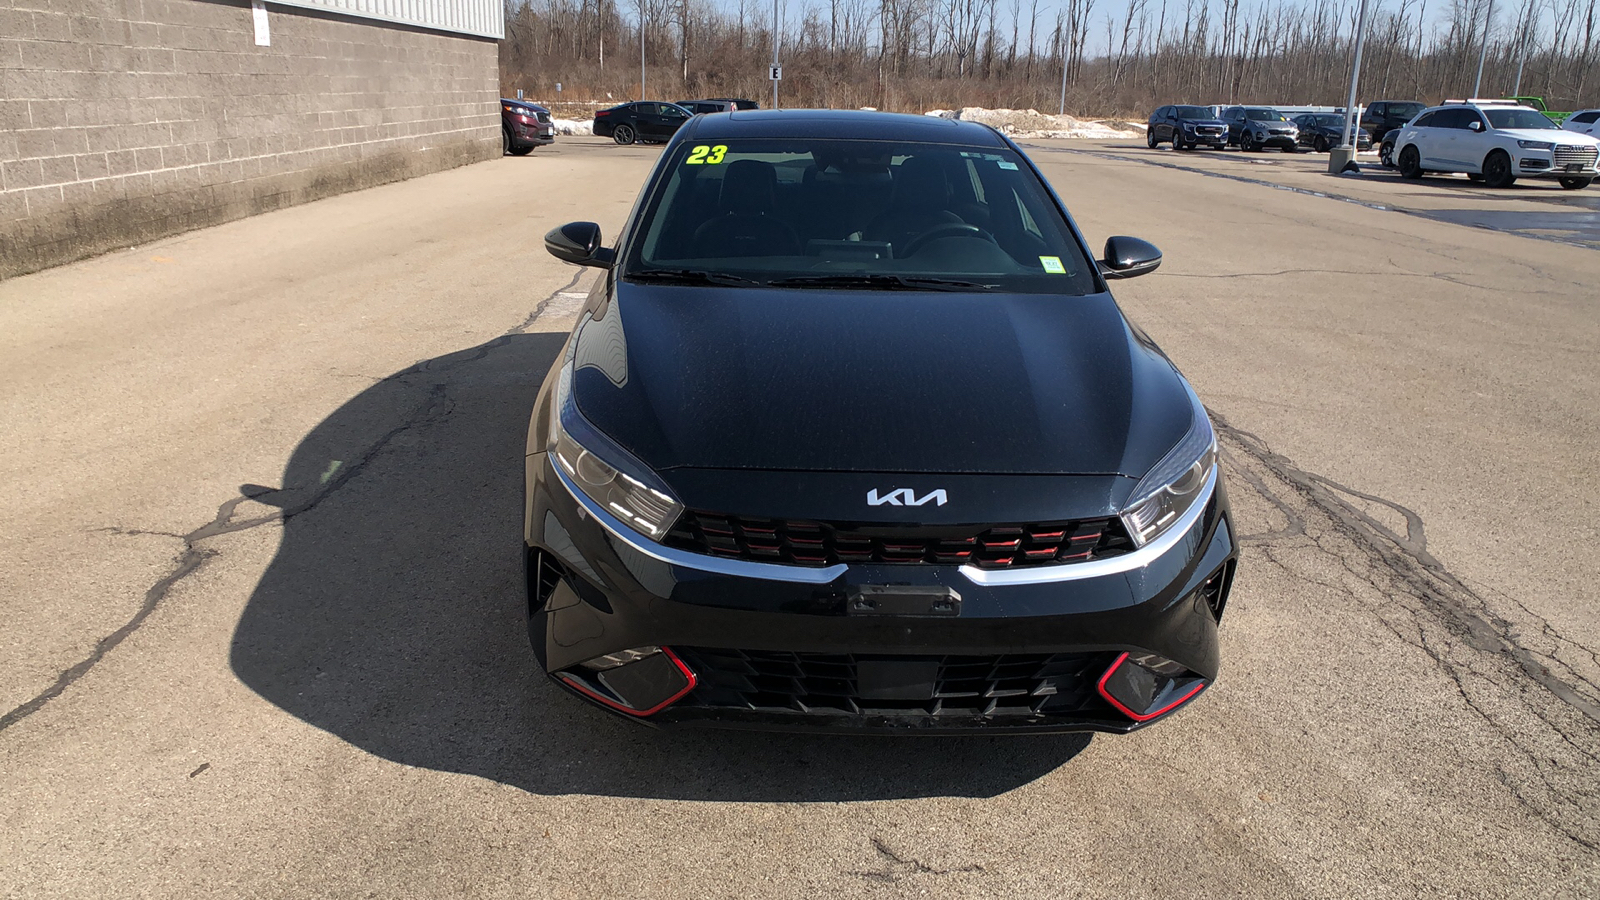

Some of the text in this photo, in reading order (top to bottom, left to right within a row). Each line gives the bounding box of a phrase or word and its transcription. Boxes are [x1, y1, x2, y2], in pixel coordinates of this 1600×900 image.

[772, 68, 779, 79] E
[685, 144, 728, 165] 23
[866, 487, 948, 507] KIA
